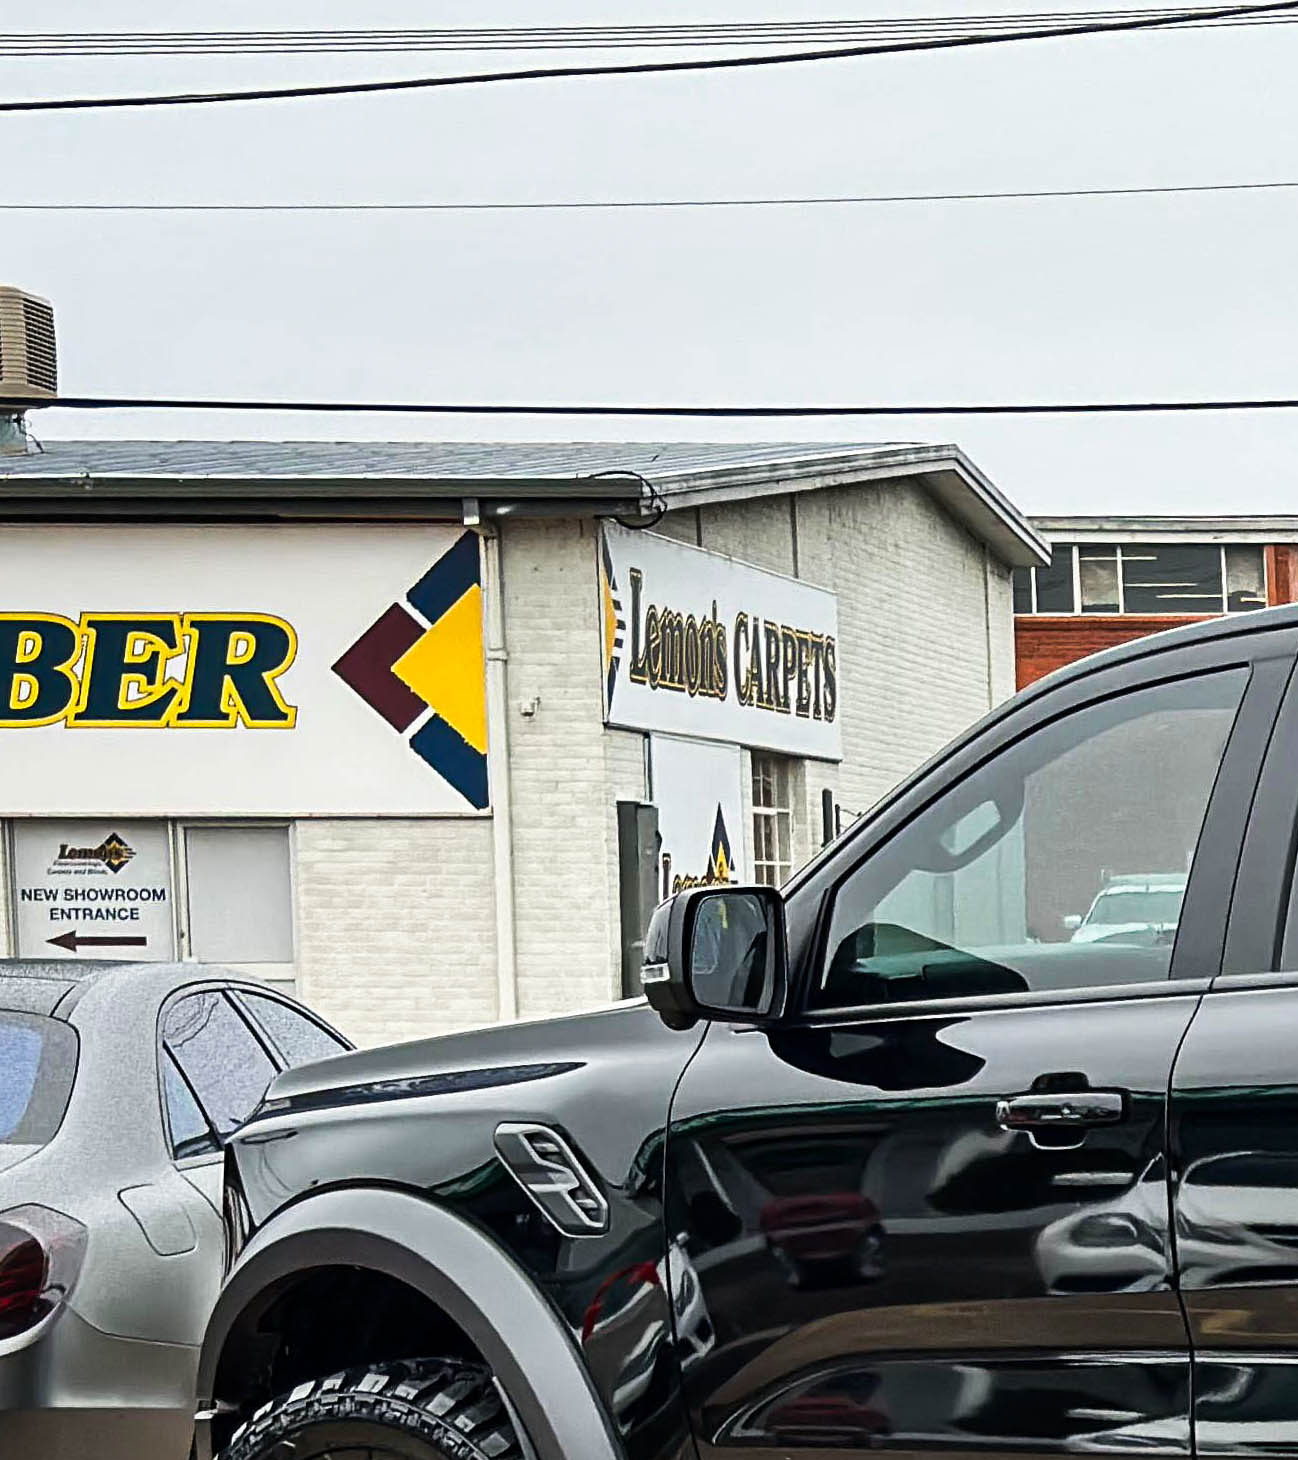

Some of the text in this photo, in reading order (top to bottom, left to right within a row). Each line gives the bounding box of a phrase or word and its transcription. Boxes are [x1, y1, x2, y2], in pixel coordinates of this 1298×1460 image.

[0, 611, 299, 728] BER
[630, 567, 837, 723] Lemon's CARPETS
[21, 888, 166, 901] NEW SHOWROOM
[50, 907, 139, 921] ENTRANCE
